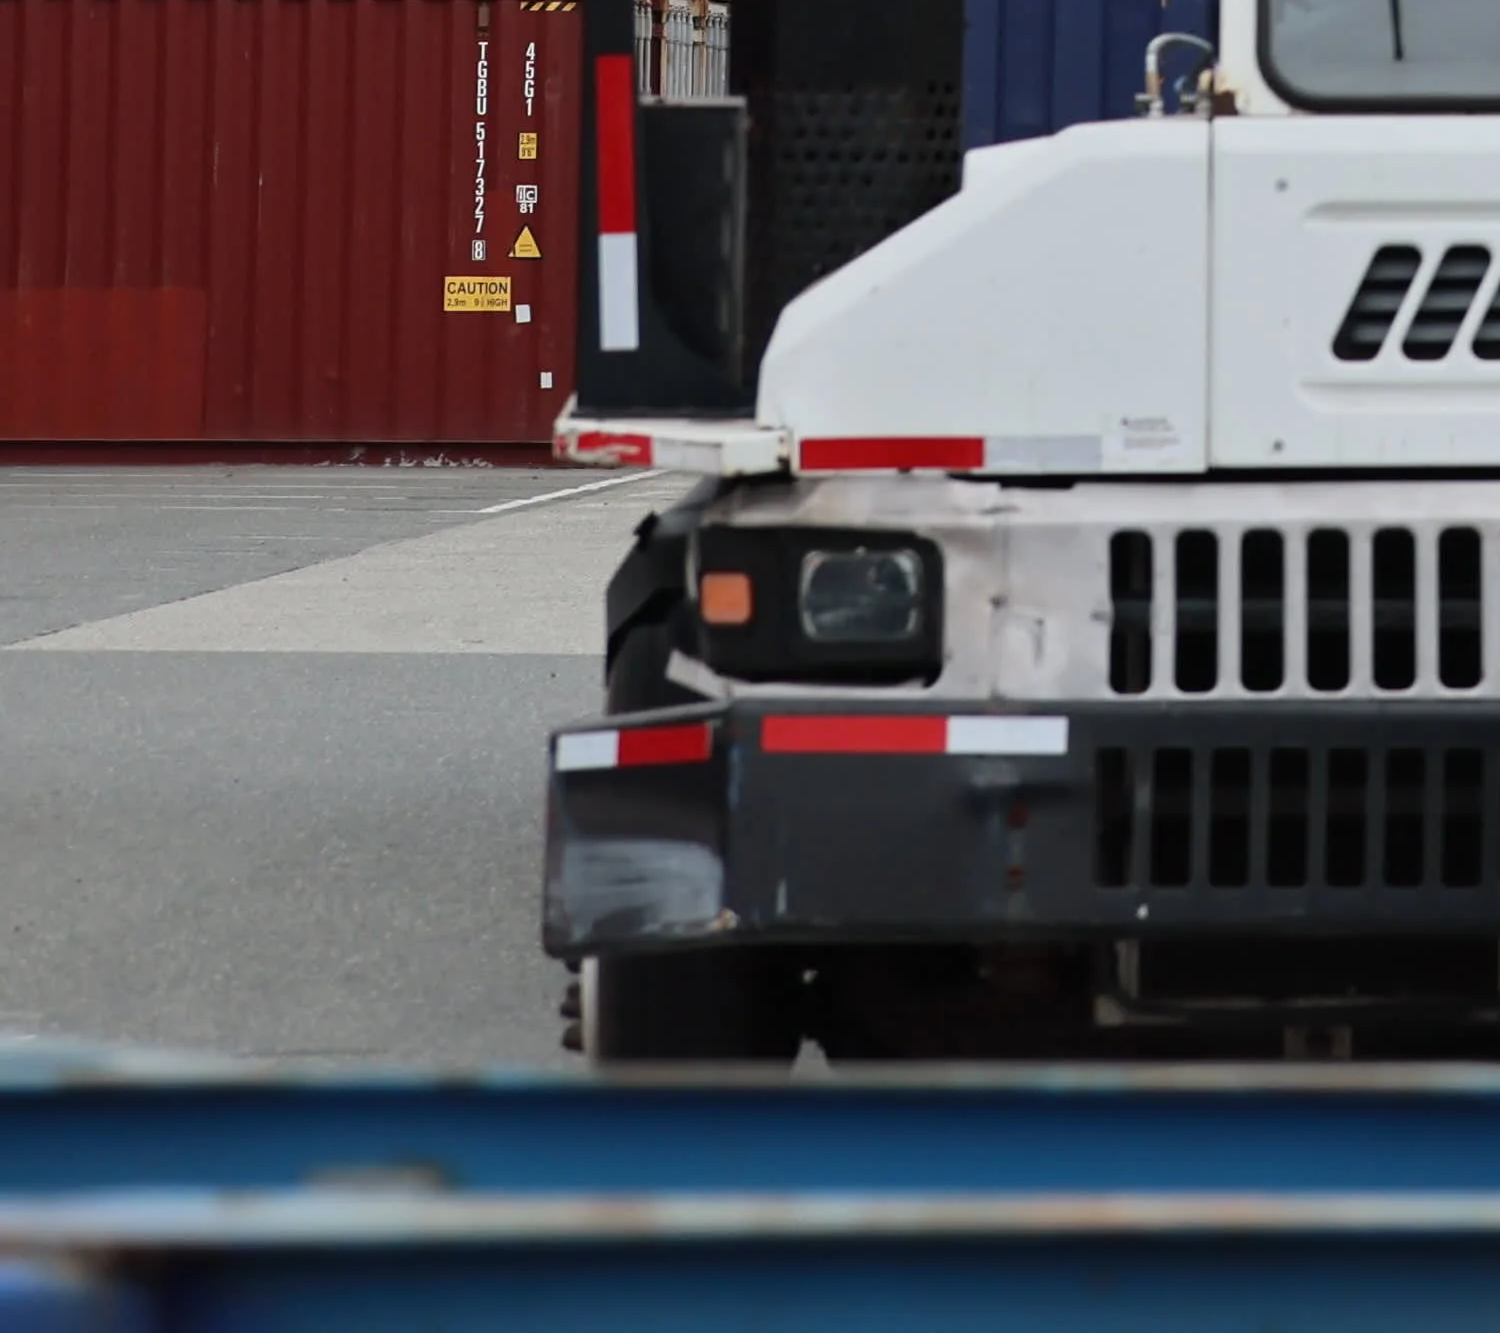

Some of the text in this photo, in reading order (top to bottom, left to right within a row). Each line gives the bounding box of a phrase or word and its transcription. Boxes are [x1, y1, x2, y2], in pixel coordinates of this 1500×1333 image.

[476, 41, 489, 116] TGBU
[524, 42, 536, 117] 45G1
[474, 122, 486, 233] 517327
[519, 203, 534, 214] 81
[447, 282, 508, 295] CAUTION
